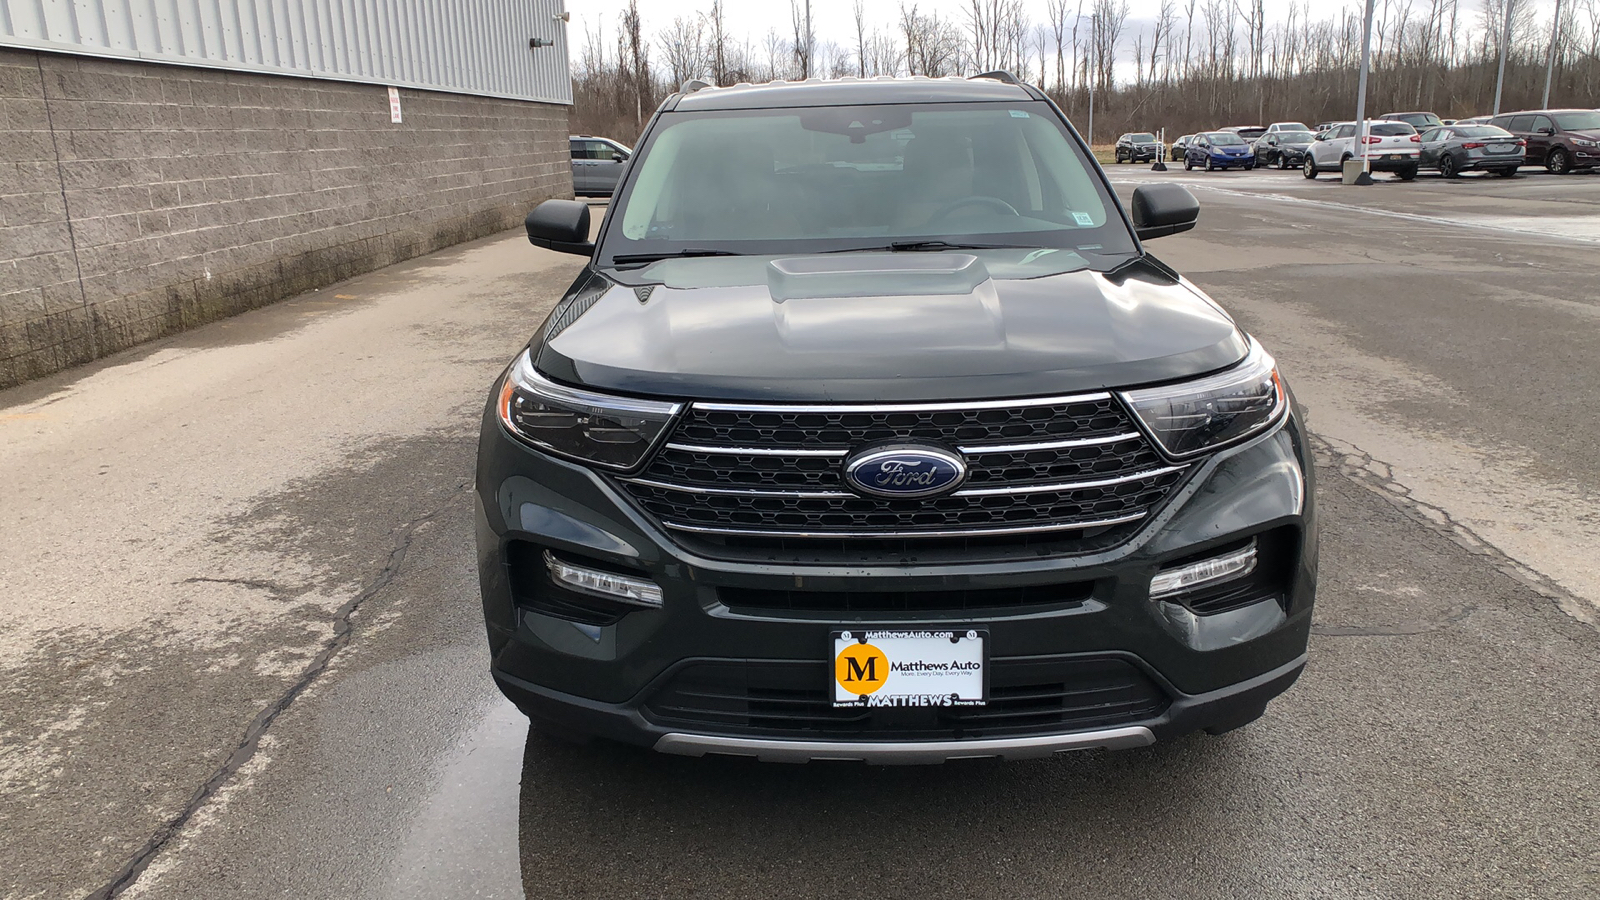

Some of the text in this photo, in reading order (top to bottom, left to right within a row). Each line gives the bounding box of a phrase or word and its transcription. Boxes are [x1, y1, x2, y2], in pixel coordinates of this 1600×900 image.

[875, 460, 937, 486] Ford
[864, 630, 954, 639] MatthewsAuto.com
[844, 656, 879, 682] M
[890, 660, 980, 672] Matthews Auto
[867, 694, 952, 707] MATTHEWS
